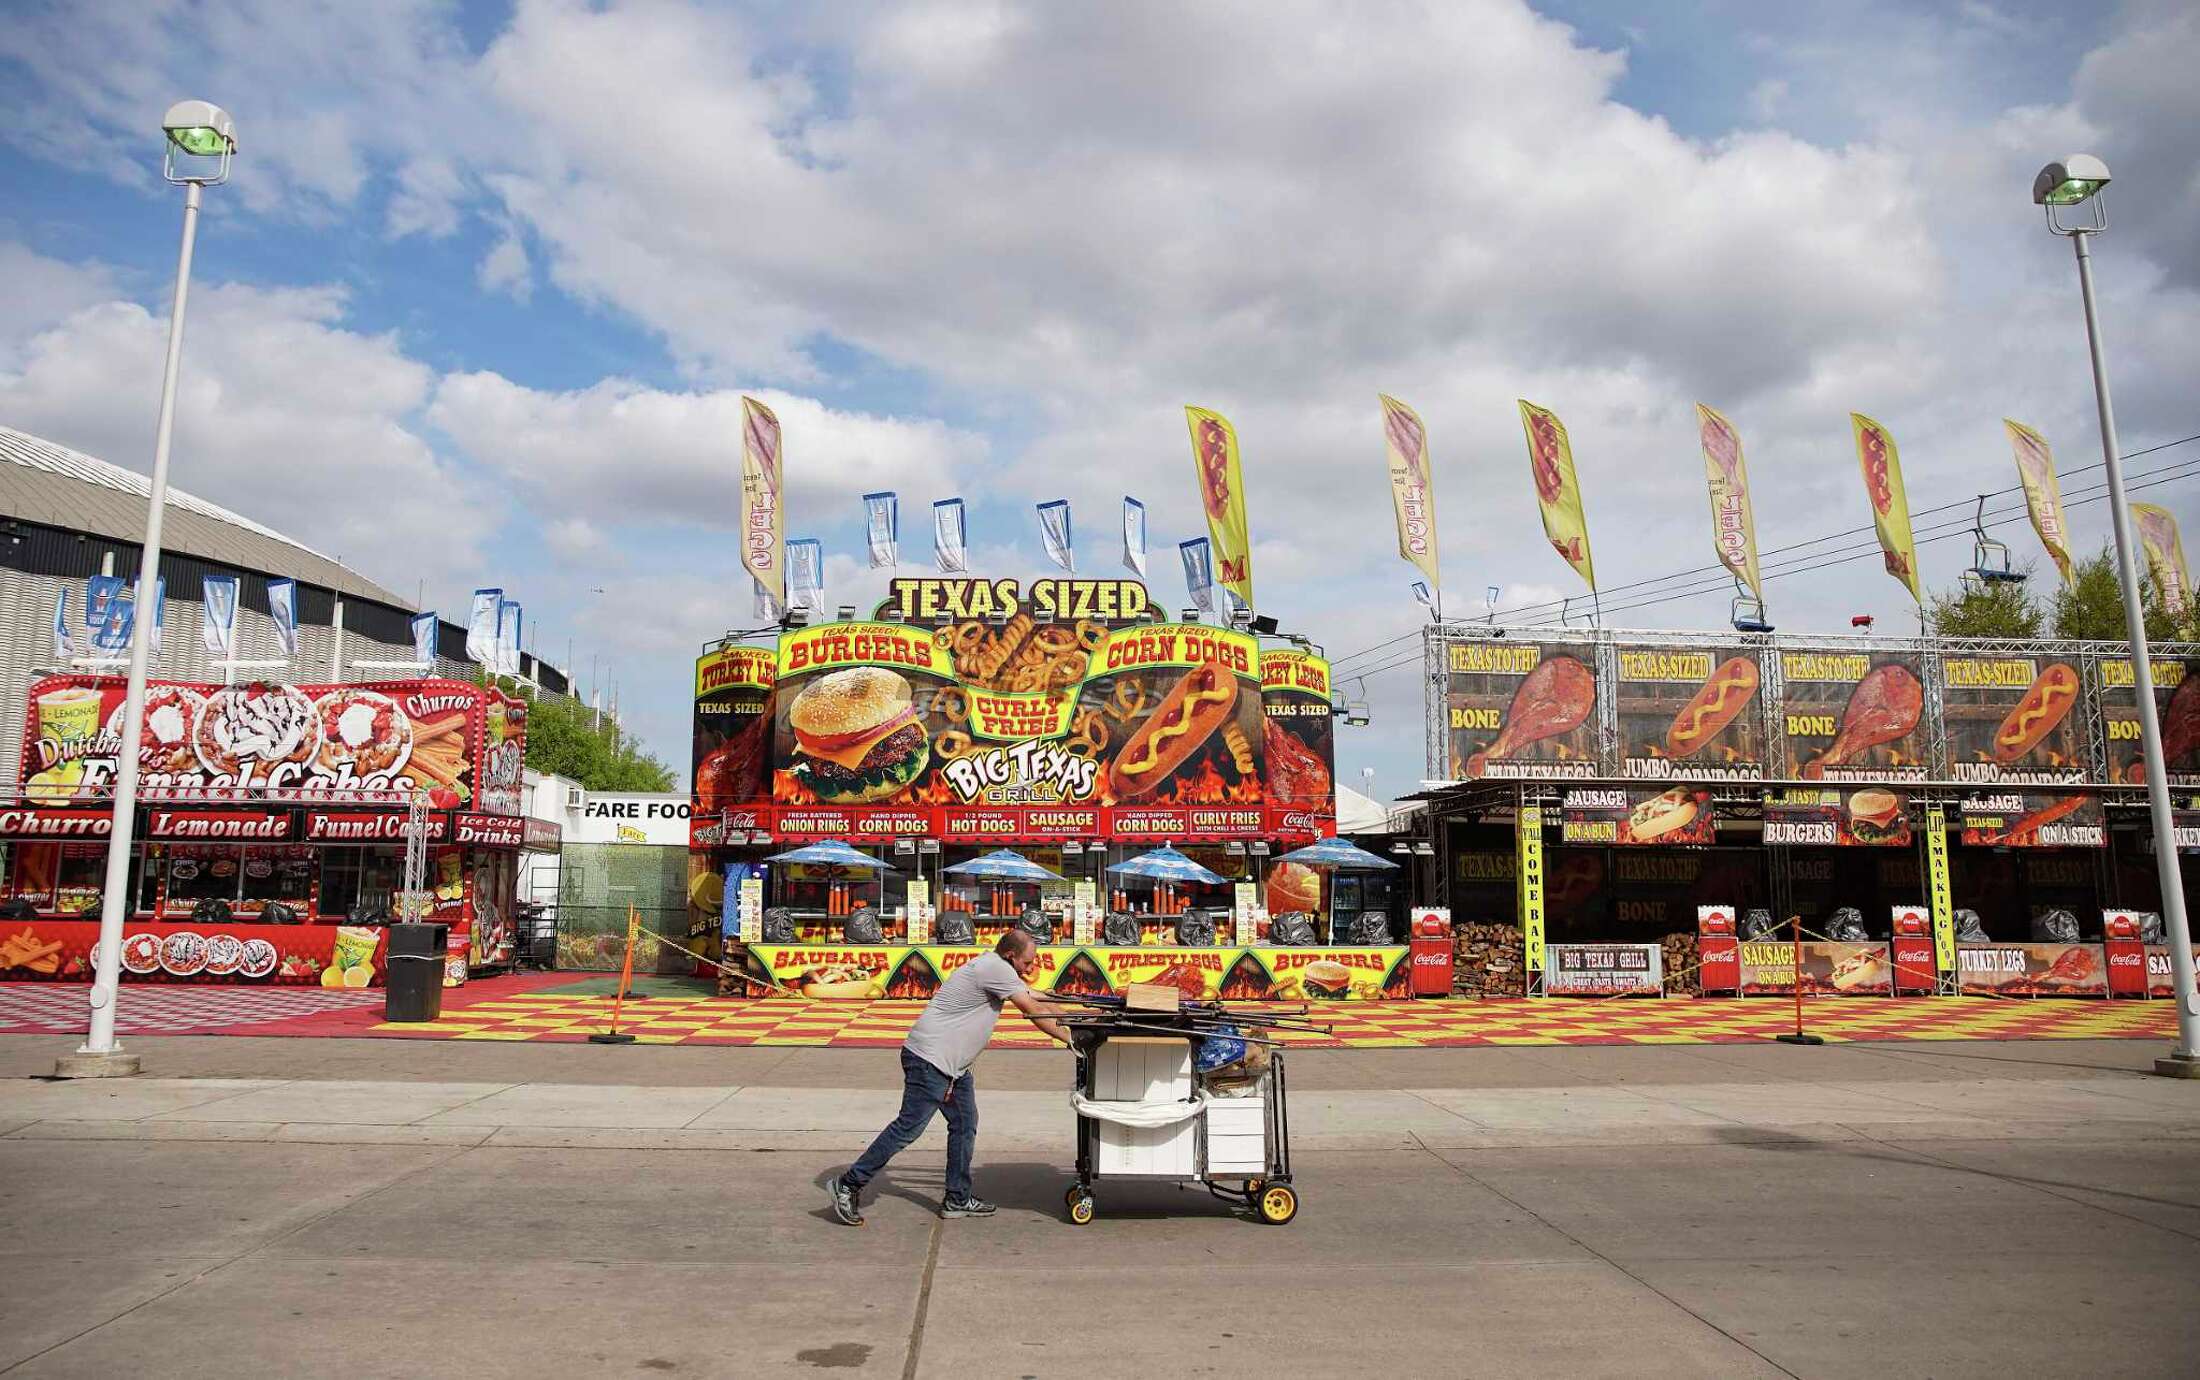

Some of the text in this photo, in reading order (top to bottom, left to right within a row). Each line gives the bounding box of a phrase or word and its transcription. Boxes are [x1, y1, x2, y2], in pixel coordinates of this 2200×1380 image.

[896, 579, 1146, 619] TEXAS SIZED
[823, 626, 857, 636] TEXAS
[1139, 627, 1174, 637] TEXAS
[720, 650, 772, 660] SMOKED
[790, 635, 932, 668] BURGERS
[1107, 635, 1249, 671] CORN DOGS
[702, 659, 754, 690] TURKEY
[2102, 663, 2135, 684] TEXA
[406, 693, 474, 718] Churros
[699, 703, 765, 714] TEXAS SIZED
[976, 697, 1058, 717] CURLY
[1266, 705, 1328, 715] TEXAS SIZED
[983, 716, 1058, 736] FRIES
[1451, 709, 1500, 729] BONE
[1787, 715, 1836, 736] BONE
[2107, 720, 2141, 740] BON
[946, 740, 1096, 798] BIG TEXAS
[1623, 758, 1669, 778] JUMBO
[1953, 763, 1998, 782] JUMBO
[266, 760, 416, 802] Cakes
[988, 788, 1057, 801] GRILL
[1567, 790, 1625, 806] SAUSAGE
[585, 802, 639, 818] FARE
[1030, 813, 1093, 826] SAUSAGE
[1193, 812, 1260, 825] CURLY FRIES
[154, 814, 287, 837] Lemonade
[310, 816, 383, 838] Funnel
[460, 816, 522, 828] Ice Cold
[781, 819, 849, 832] ONION RINGS
[859, 820, 928, 832] CORN DOGS
[952, 820, 1015, 832] HOT DOGS
[1116, 819, 1184, 832] CORN DOGS
[1567, 824, 1582, 838] ON
[1927, 815, 1944, 832] LIP
[456, 827, 521, 844] Drinks
[1766, 823, 1834, 842] BURGERS
[2043, 826, 2102, 844] ON A STICK
[1527, 844, 1538, 901] COME
[1933, 835, 1948, 929] SMACKING
[691, 922, 706, 936] BIG
[1529, 910, 1540, 970] BACK
[774, 951, 890, 970] SAUSAGE
[1108, 953, 1223, 972] TURKEY LEGS
[1565, 953, 1646, 968] BIG TEXAS GRILL
[1743, 945, 1796, 966] SAUSAGE
[1959, 951, 2026, 972] TURKEY LEGS
[1759, 972, 1771, 984] ON
